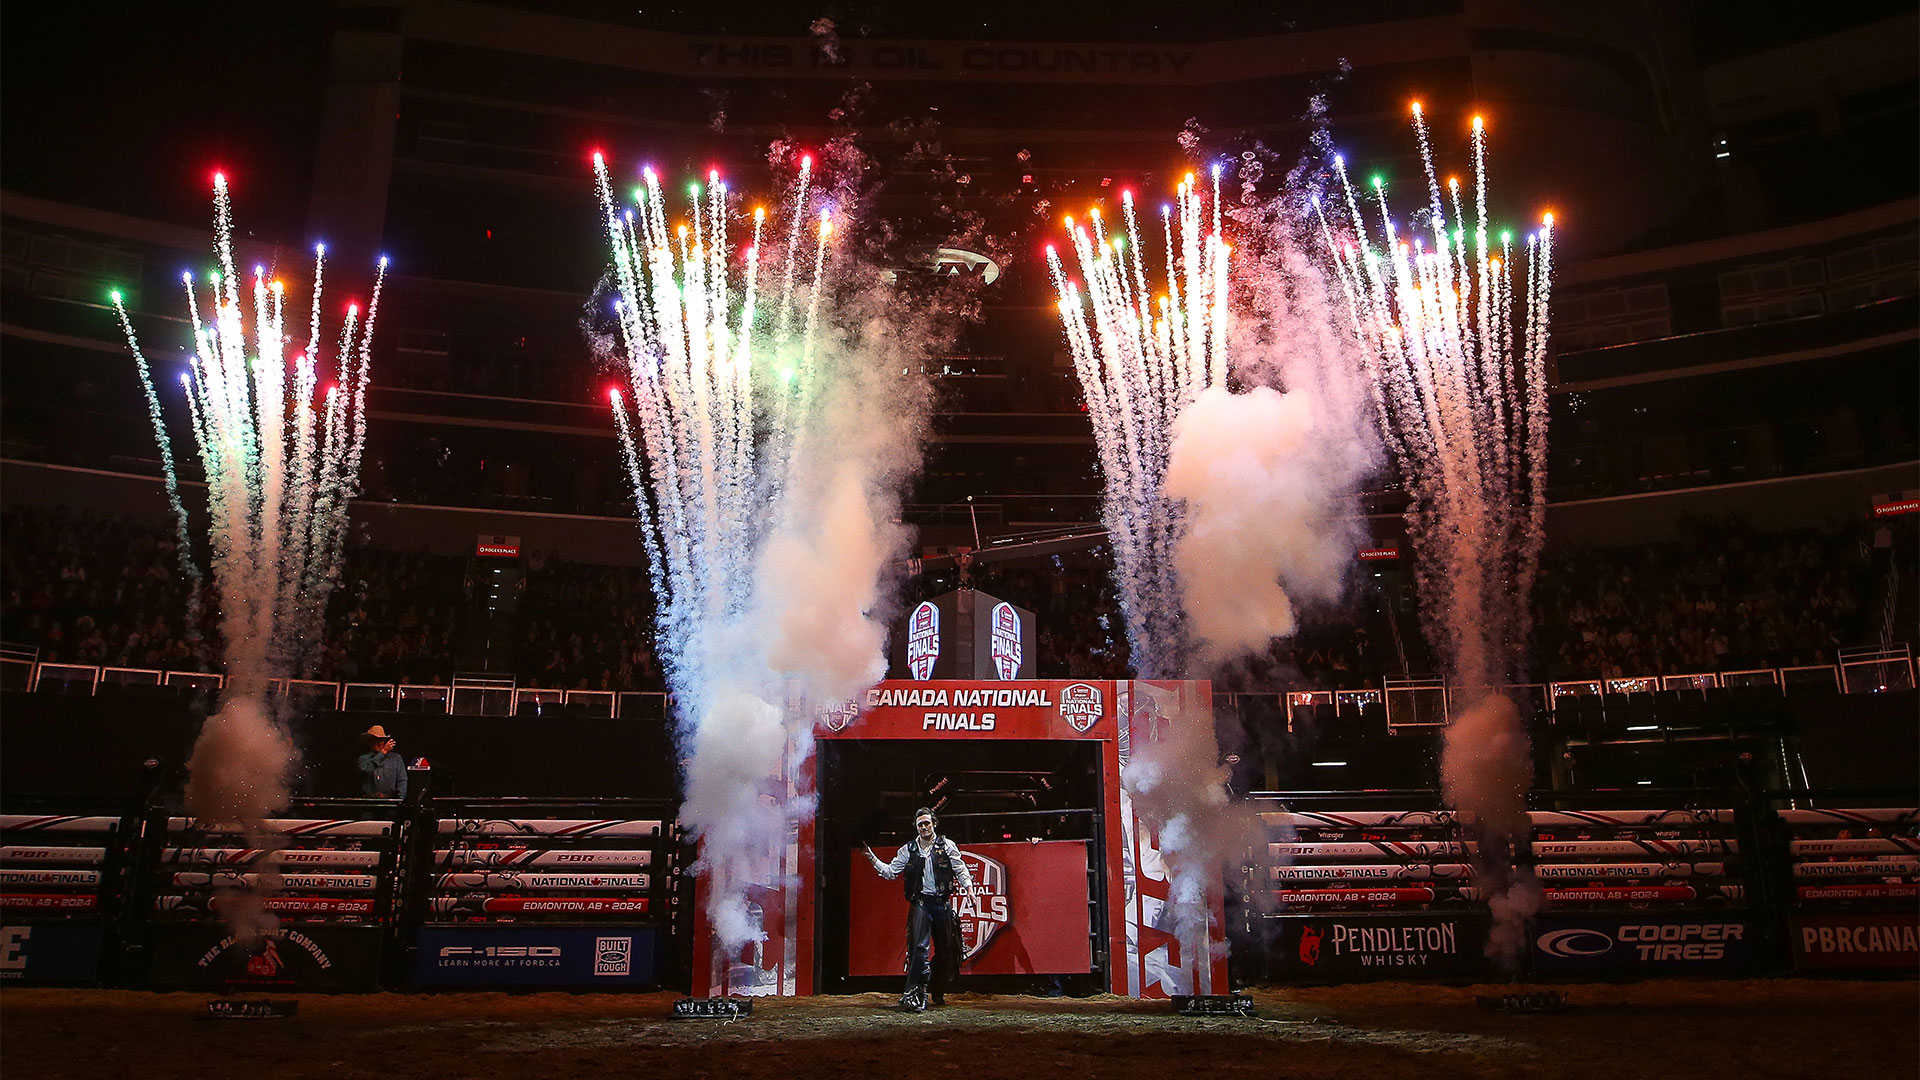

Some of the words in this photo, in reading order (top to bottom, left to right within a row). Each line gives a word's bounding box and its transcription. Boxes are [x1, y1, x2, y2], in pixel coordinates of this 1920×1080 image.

[871, 46, 944, 70] OIL
[962, 47, 1194, 74] COUNTRY
[908, 635, 940, 665] FINALS
[992, 635, 1022, 666] FINALS
[866, 689, 950, 708] CANADA
[952, 689, 1052, 708] NATIONAL
[1060, 704, 1103, 716] FINALS
[922, 713, 995, 731] FINALS
[557, 854, 595, 862] PBR
[1278, 869, 1341, 878] NATIONAL
[1345, 868, 1388, 878] FINALS
[1541, 867, 1600, 876] NATIONAL
[1607, 867, 1650, 876] FINALS
[328, 879, 371, 888] FINALS
[531, 877, 592, 887] NATIONAL
[600, 878, 645, 887] FINALS
[1282, 893, 1343, 903] EDMONTON,
[1345, 893, 1359, 901] AB
[1367, 892, 1397, 900] 2024
[311, 902, 329, 910] AB
[336, 902, 369, 912] 2024
[522, 901, 586, 912] EDMONTON,
[586, 902, 602, 910] AB
[611, 902, 643, 911] 2024
[1617, 923, 1745, 943] COOPER
[1331, 922, 1457, 956] PENDLETON
[197, 946, 221, 968] THE
[289, 930, 332, 969] COMPANY
[599, 940, 629, 951] BUILT
[440, 946, 561, 957] F-150
[1636, 943, 1726, 961] TIRES
[439, 959, 469, 968] LEARN
[473, 959, 502, 968] MORE
[504, 959, 516, 968] AT
[519, 959, 561, 968] FORD.CA
[1361, 954, 1428, 966] WHISKY
[599, 963, 627, 972] TOUGH
